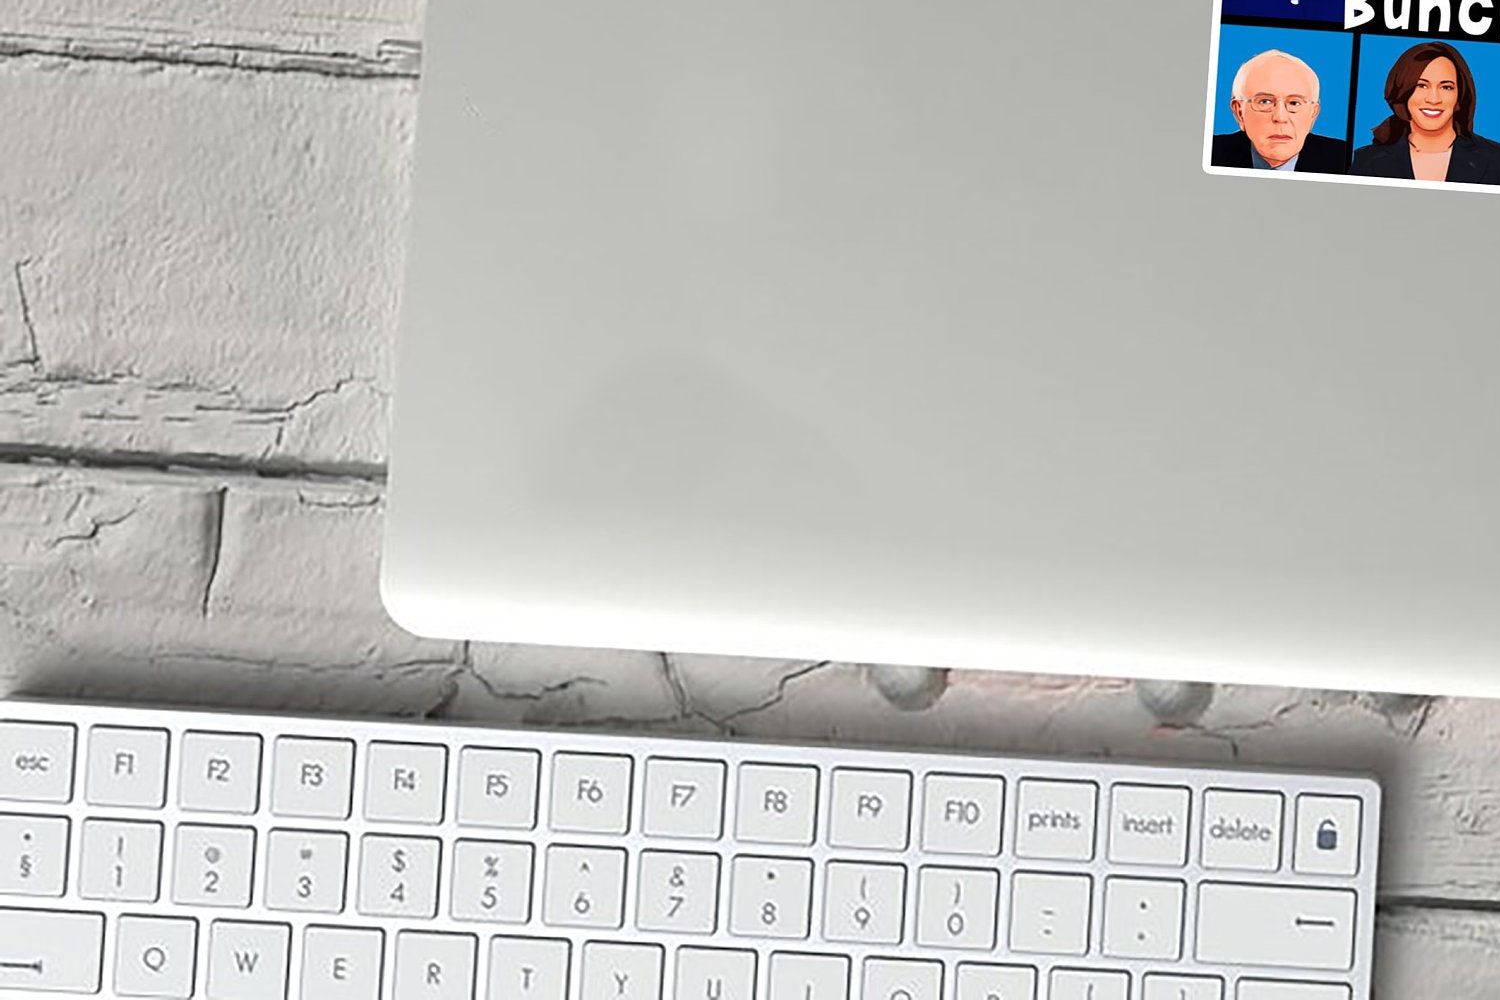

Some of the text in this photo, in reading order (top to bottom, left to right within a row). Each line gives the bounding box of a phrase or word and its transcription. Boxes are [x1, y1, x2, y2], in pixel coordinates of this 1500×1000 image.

[15, 755, 50, 772] esc
[114, 752, 134, 775] F1
[207, 758, 231, 782] F2
[300, 763, 324, 787] F3
[393, 768, 416, 791] F4
[485, 774, 509, 798] F5
[576, 779, 604, 804] F6
[670, 784, 697, 808] F7
[763, 789, 788, 814] F8
[857, 794, 883, 818] F9
[944, 799, 981, 825] F10
[1027, 806, 1083, 832] prints
[1208, 817, 1273, 844] delete
[204, 870, 221, 894] 2
[297, 875, 313, 899] 3
[389, 882, 406, 903] 4
[480, 885, 498, 910] 5
[574, 892, 591, 915] 6
[667, 895, 685, 918] 7
[761, 901, 777, 926] 8
[854, 906, 872, 930] 9
[142, 946, 167, 974] Q
[234, 951, 260, 975] W
[332, 957, 348, 980] E
[426, 962, 442, 986] R
[520, 967, 535, 990] T
[613, 972, 629, 996] Y
[706, 978, 722, 1000] U
